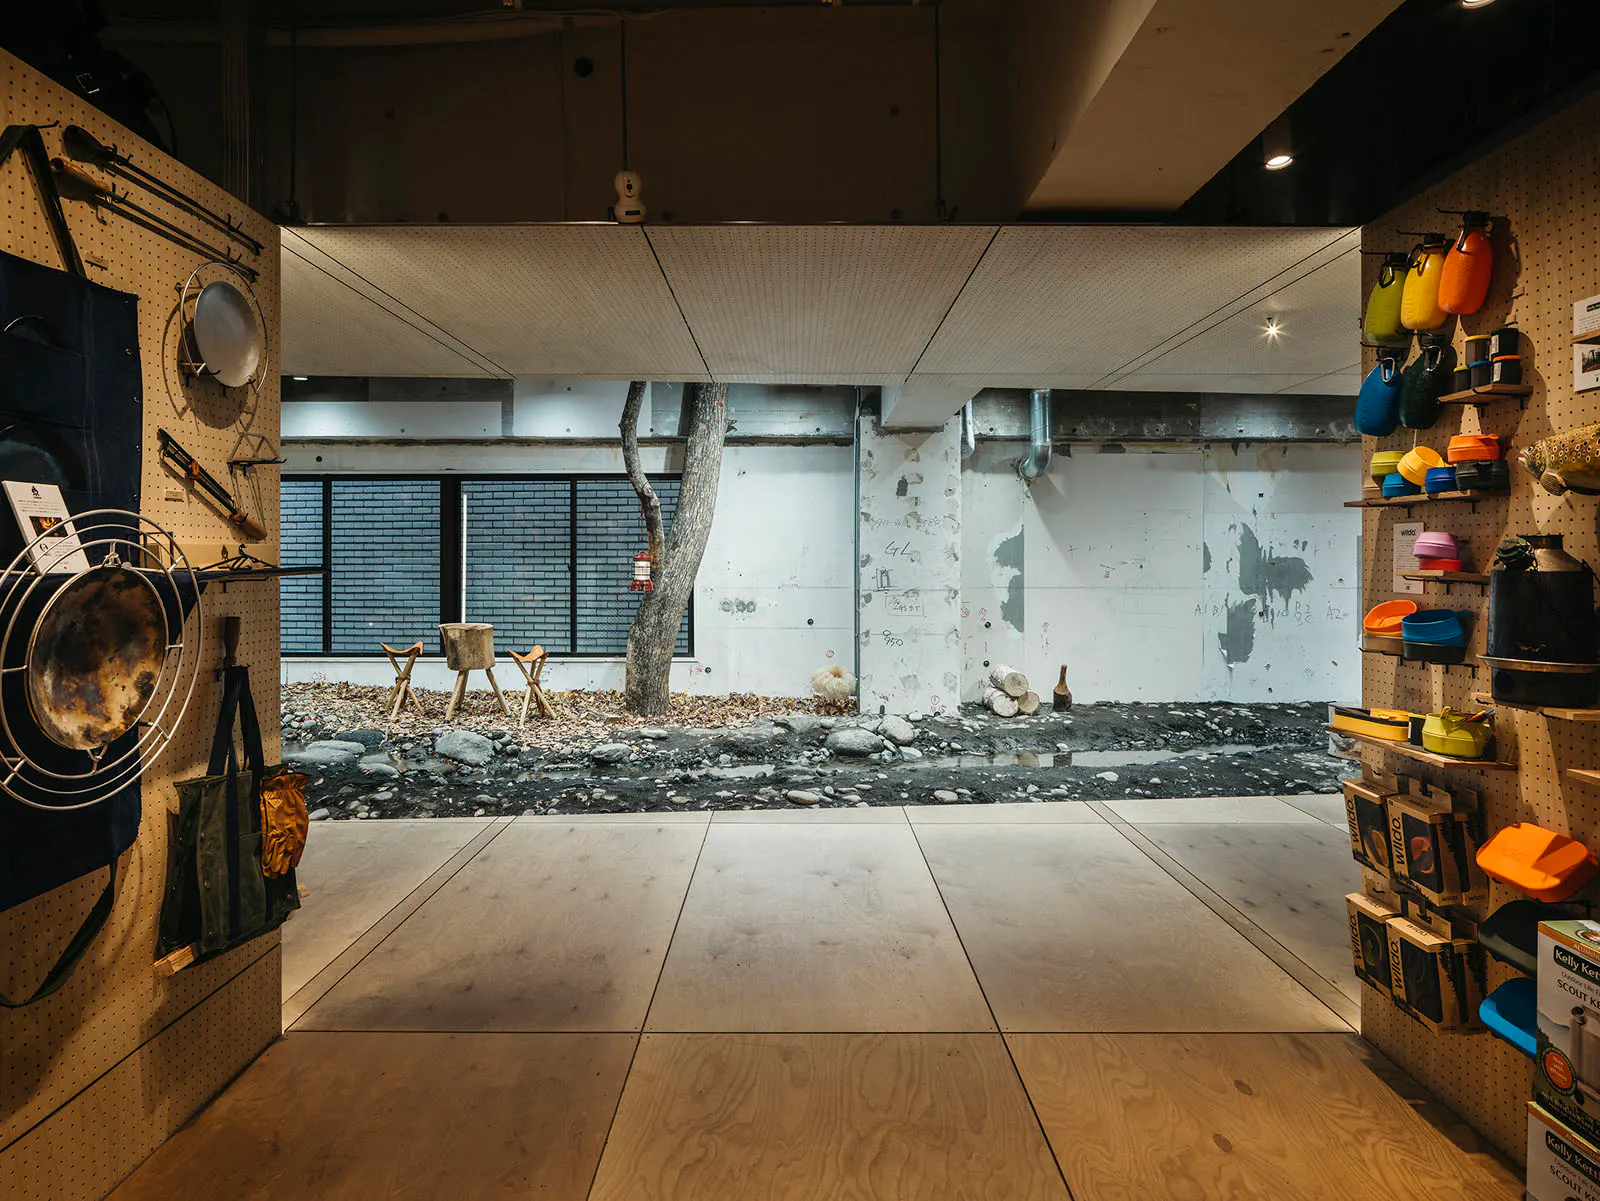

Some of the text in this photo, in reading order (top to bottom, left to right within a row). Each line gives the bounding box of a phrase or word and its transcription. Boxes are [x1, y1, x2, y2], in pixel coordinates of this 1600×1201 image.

[1392, 816, 1405, 865] wildo.
[1390, 940, 1403, 989] wildo.
[1555, 949, 1579, 971] Kelly
[1557, 979, 1588, 1001] SCOUT
[1547, 1135, 1572, 1161] Kelly
[1550, 1165, 1582, 1194] SCOUT
